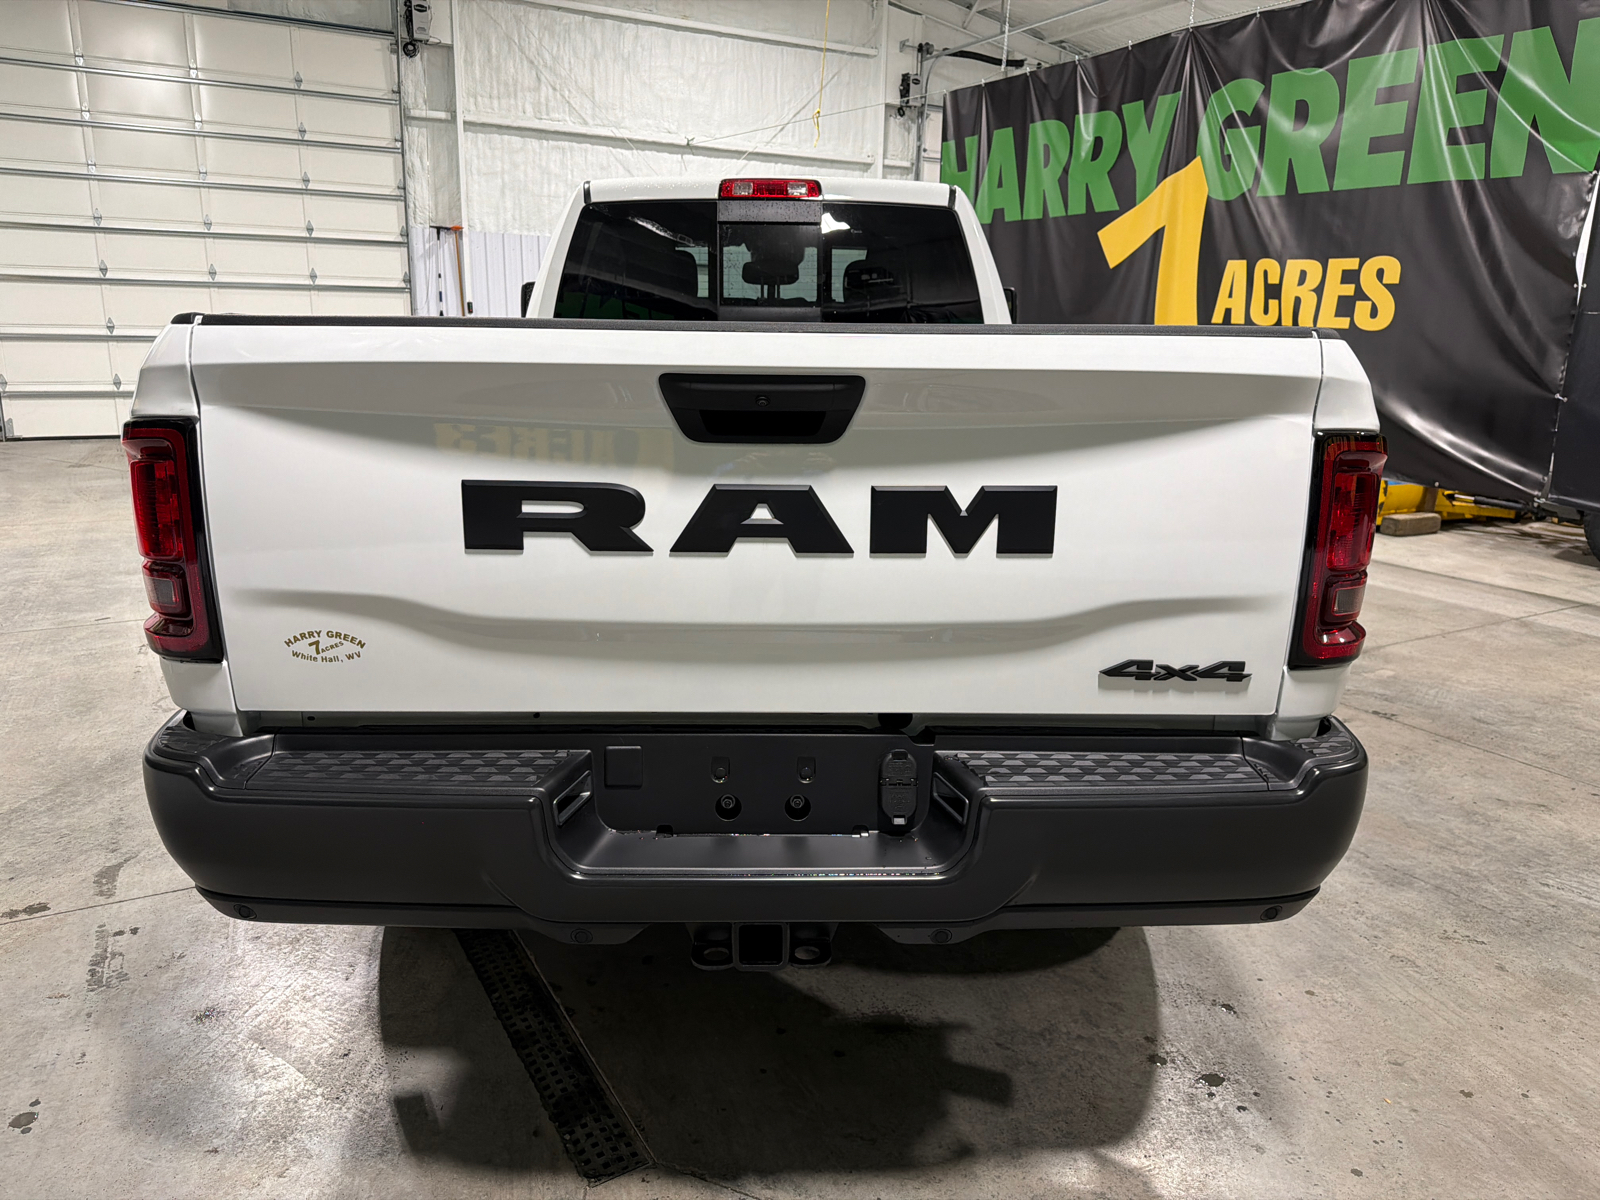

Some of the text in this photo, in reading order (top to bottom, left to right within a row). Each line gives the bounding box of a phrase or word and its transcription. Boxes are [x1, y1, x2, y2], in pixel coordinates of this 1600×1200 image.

[940, 18, 1600, 224] HARRY GREEN
[1097, 155, 1402, 331] 7 ACRES
[461, 479, 1058, 557] RAM
[284, 629, 366, 649] HARRY GREEN
[308, 639, 344, 655] 7 ACRES
[291, 649, 361, 663] White Hall, WV
[1098, 658, 1253, 682] 4x4
